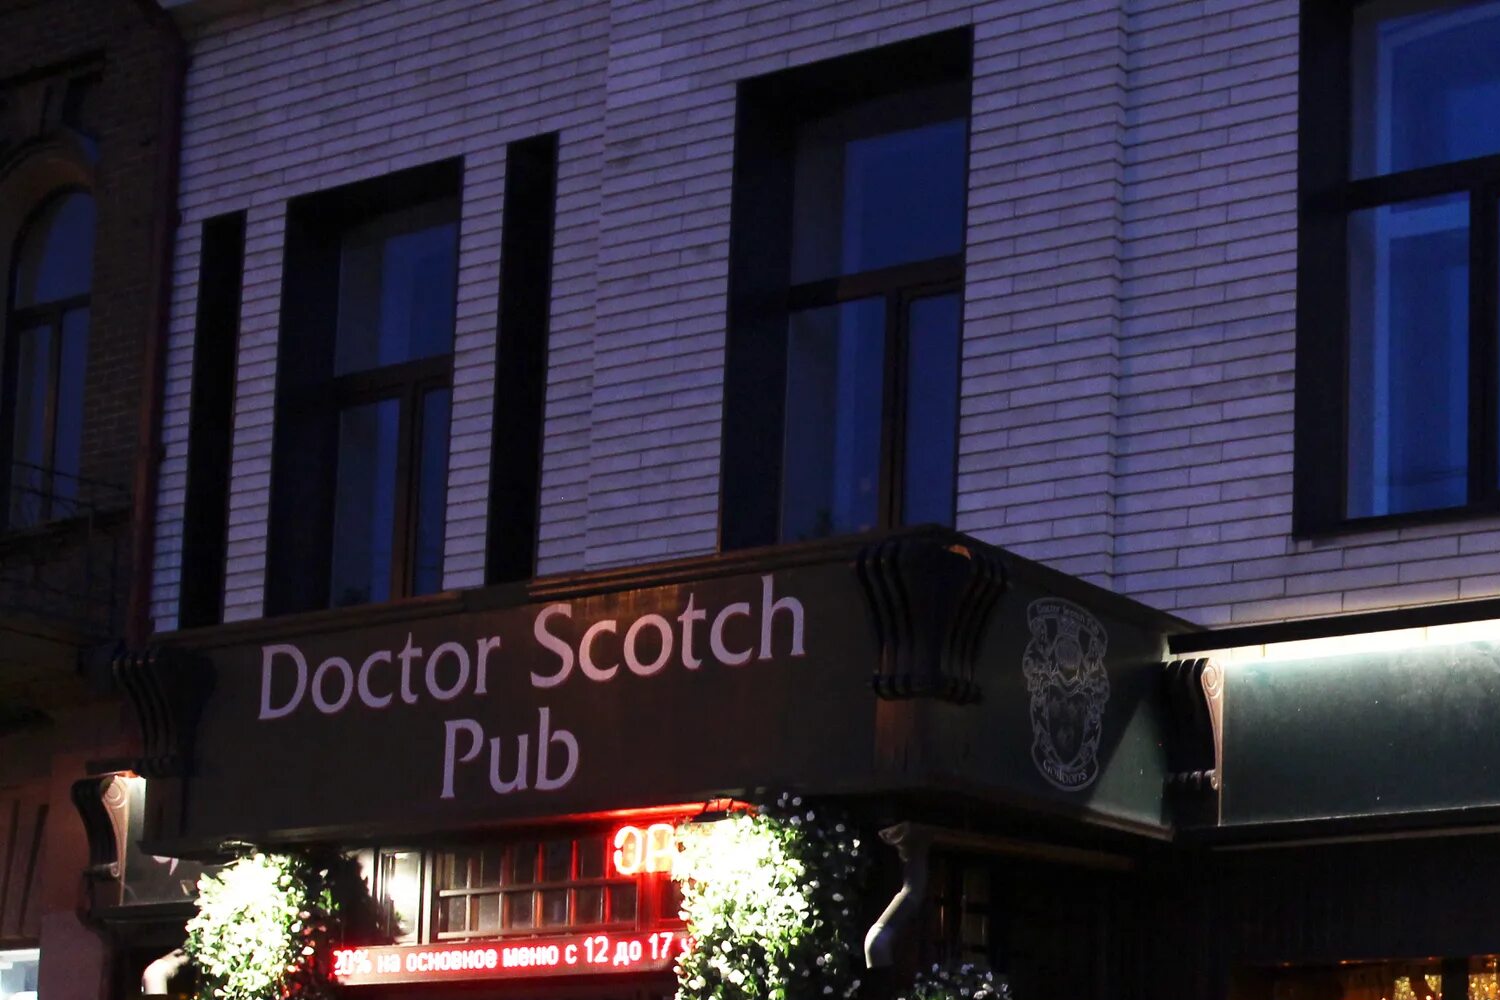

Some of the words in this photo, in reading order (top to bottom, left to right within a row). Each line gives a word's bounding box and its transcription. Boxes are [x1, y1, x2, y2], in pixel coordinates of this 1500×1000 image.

[258, 632, 502, 720] Doctor
[529, 575, 806, 689] Scotch
[440, 706, 580, 799] Pub
[377, 953, 401, 973] на
[405, 948, 498, 973] основное
[502, 943, 559, 968] меню
[565, 944, 578, 965] с
[583, 935, 609, 964] 12
[612, 940, 642, 967] до
[648, 931, 674, 960] 17
